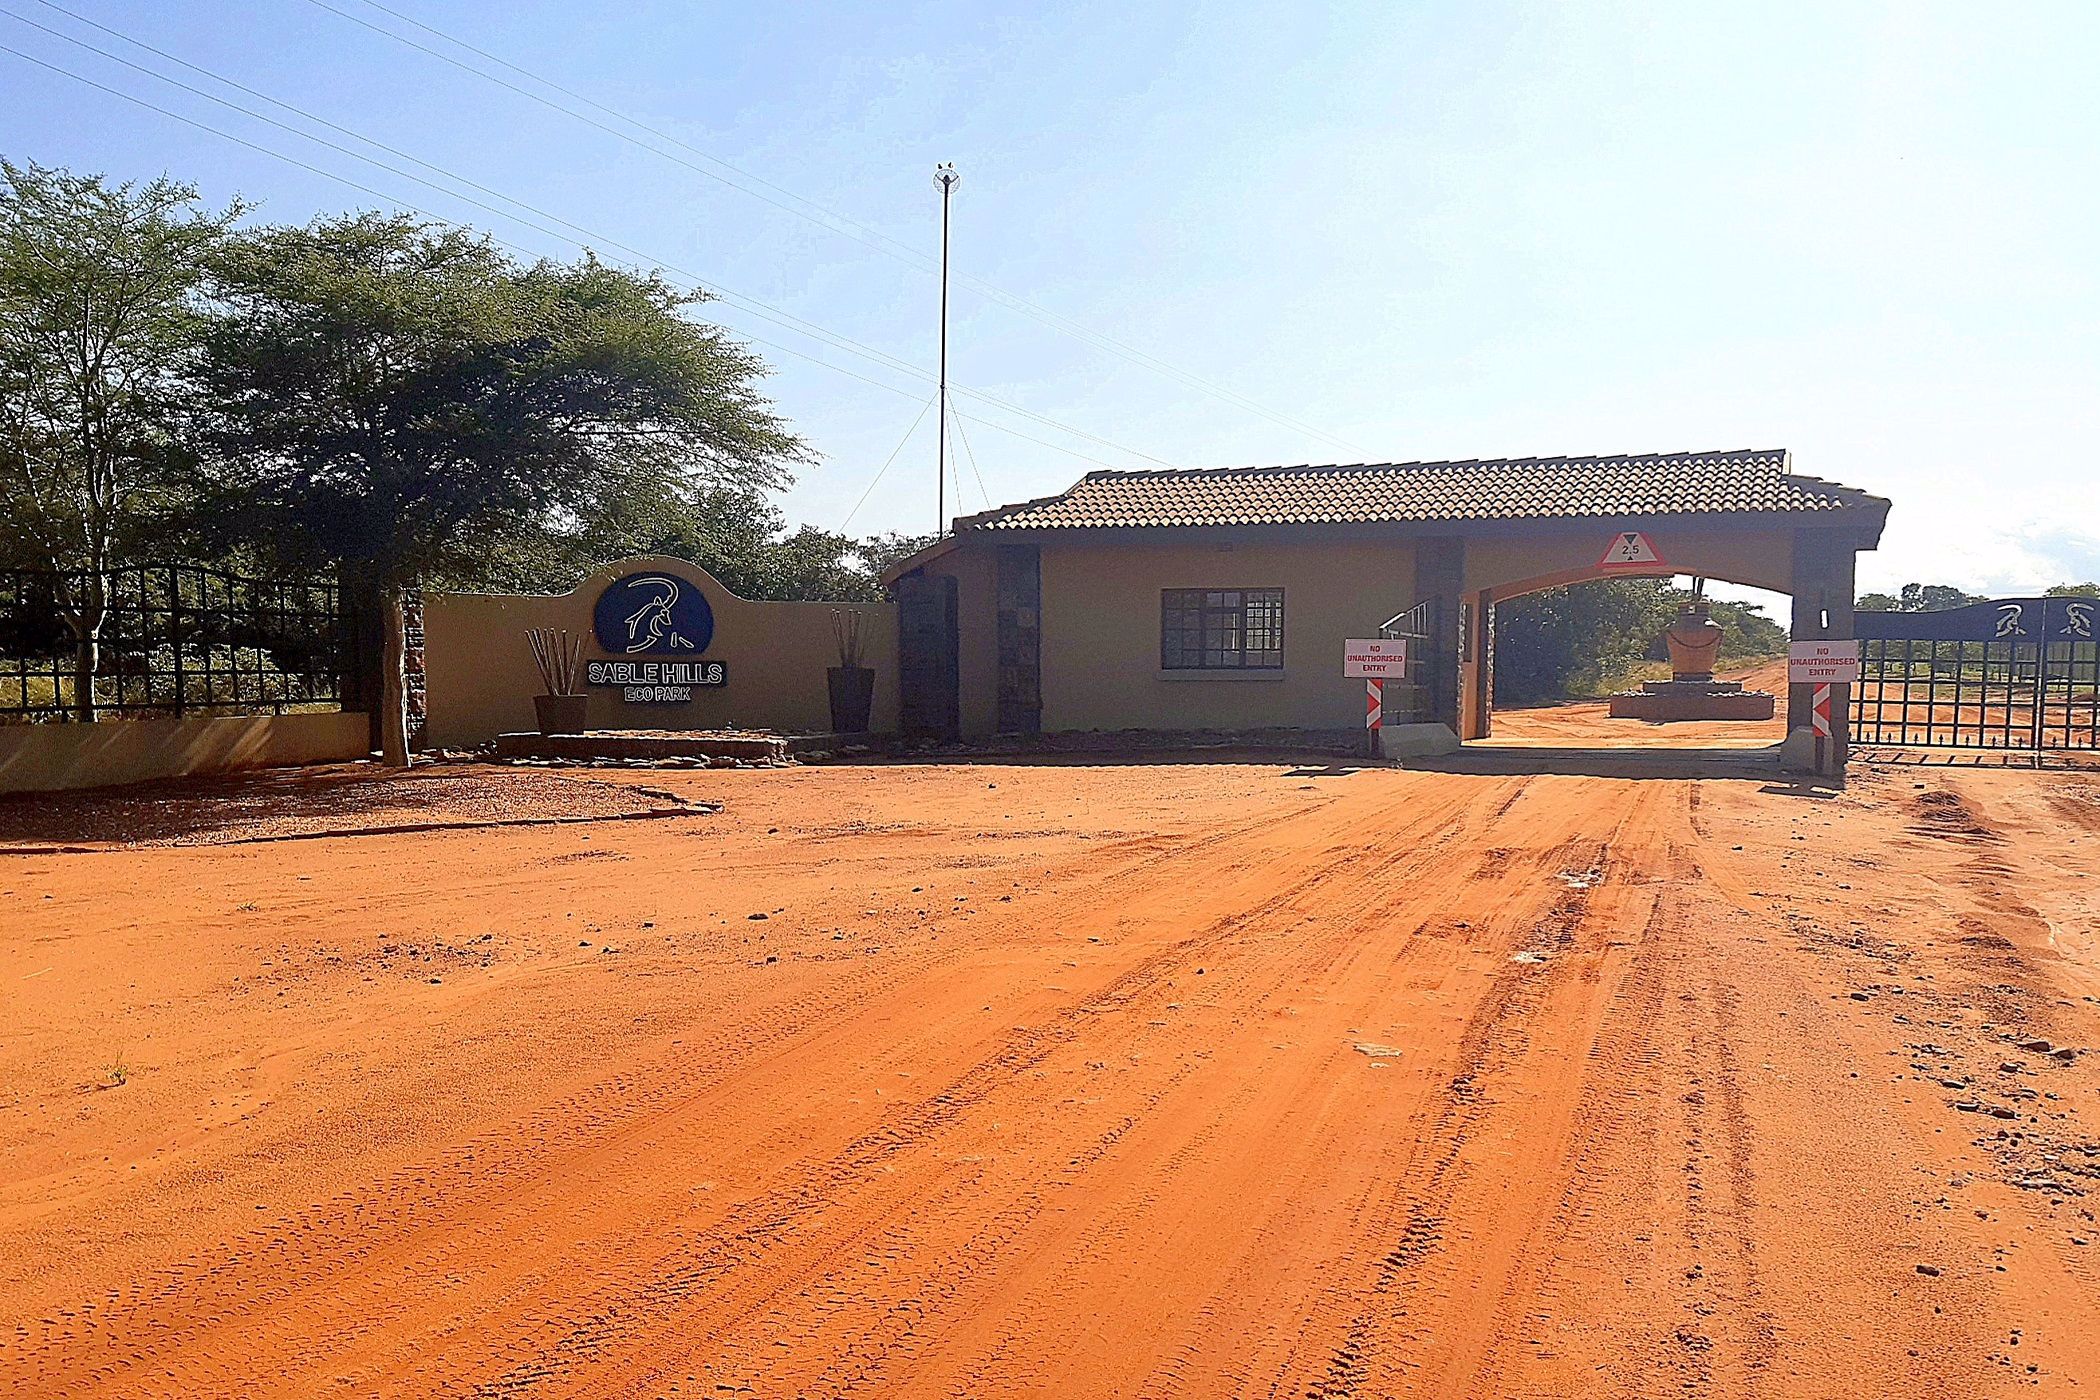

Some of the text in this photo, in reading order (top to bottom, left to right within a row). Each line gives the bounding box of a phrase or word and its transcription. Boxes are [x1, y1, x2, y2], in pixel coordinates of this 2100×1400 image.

[1622, 545, 1640, 555] 2.5
[1369, 645, 1381, 653] NO
[1790, 658, 1856, 666] UNAUTHORISED
[1362, 664, 1387, 672] ENTRY
[1808, 668, 1837, 676] ENTRY
[588, 662, 723, 684] SABLE HILLS
[624, 687, 691, 702] ECO PARK
